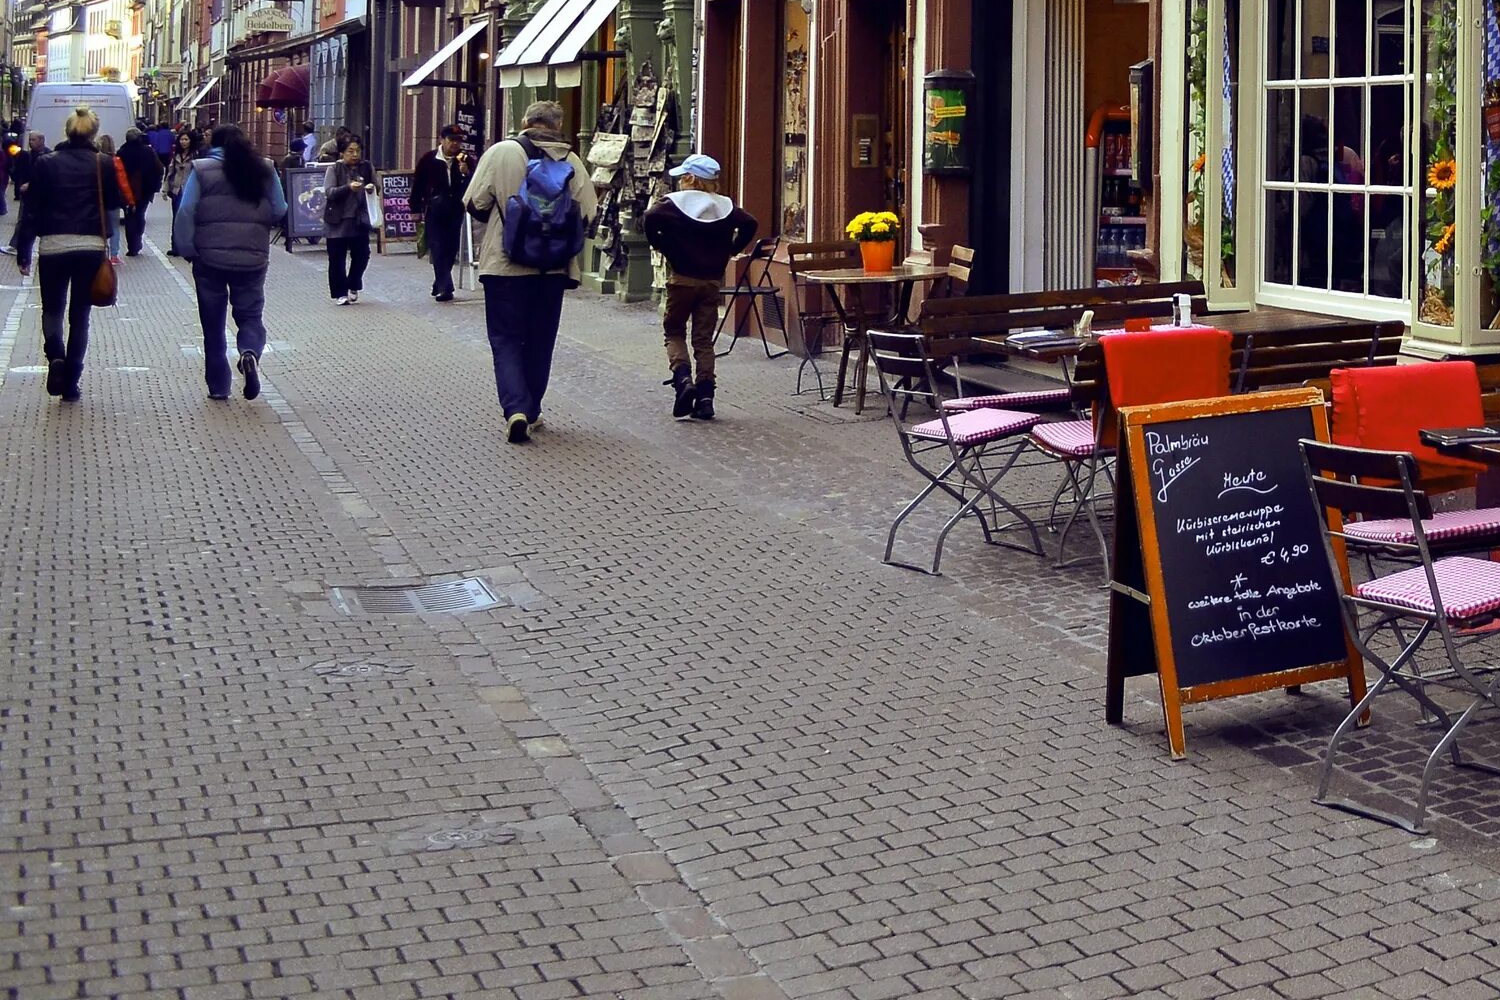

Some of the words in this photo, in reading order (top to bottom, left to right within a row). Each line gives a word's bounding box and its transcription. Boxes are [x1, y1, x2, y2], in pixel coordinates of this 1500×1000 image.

[247, 20, 293, 31] Heidelberg
[383, 176, 409, 188] FRESH
[1146, 431, 1209, 456] Palmbräu
[1223, 468, 1267, 489] Heute
[1195, 528, 1215, 543] mit
[1266, 579, 1322, 599] Angebote
[1236, 605, 1252, 622] in
[1255, 605, 1280, 619] der
